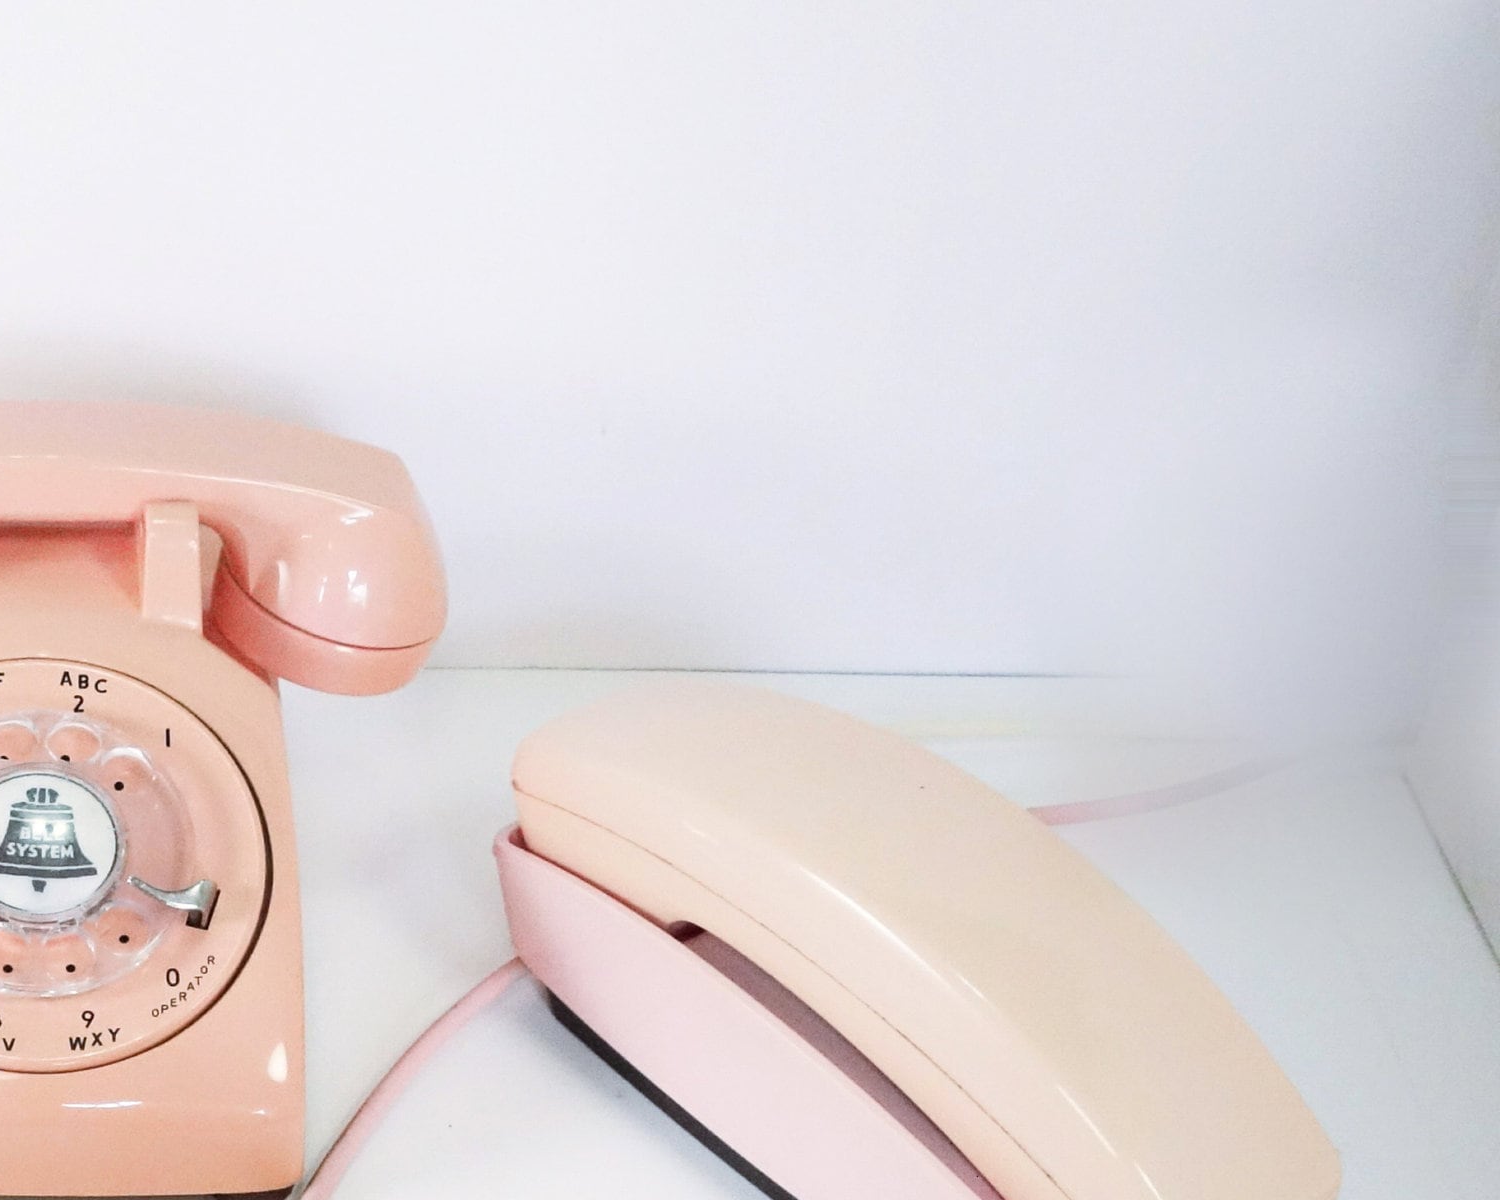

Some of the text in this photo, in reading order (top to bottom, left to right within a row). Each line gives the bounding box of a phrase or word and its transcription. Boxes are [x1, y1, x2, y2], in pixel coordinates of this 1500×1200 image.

[59, 671, 108, 693] ABC
[73, 695, 85, 713] 2
[5, 842, 75, 859] SYSTEM
[151, 955, 216, 1018] OPERATOR
[165, 967, 180, 987] 0
[81, 1010, 95, 1029] 9
[68, 1028, 121, 1051] WXY
